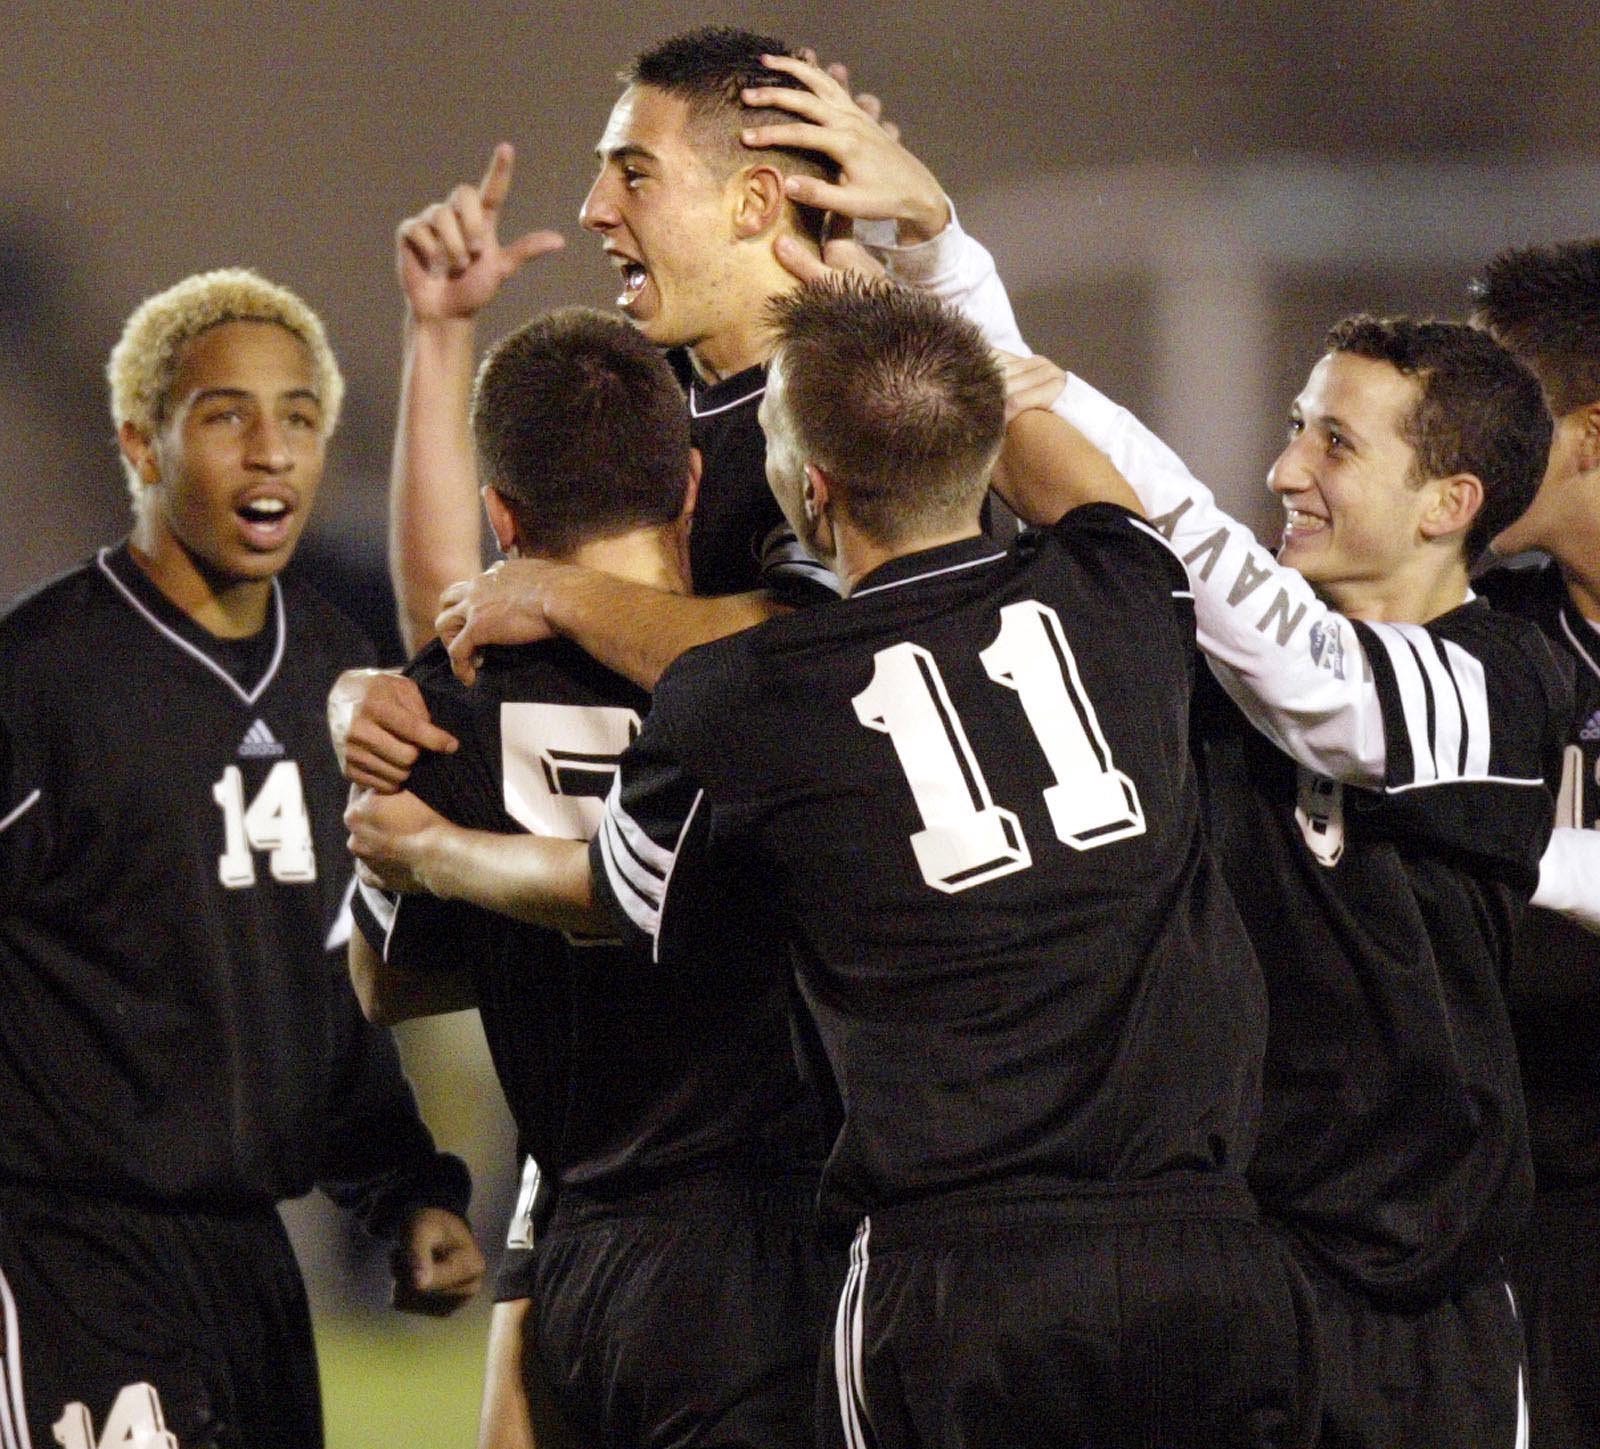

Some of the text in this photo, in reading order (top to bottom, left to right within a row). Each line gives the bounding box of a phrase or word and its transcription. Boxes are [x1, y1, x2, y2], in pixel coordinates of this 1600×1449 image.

[1150, 497, 1308, 647] NAVY
[851, 599, 1147, 894] 11
[212, 760, 317, 888] 14
